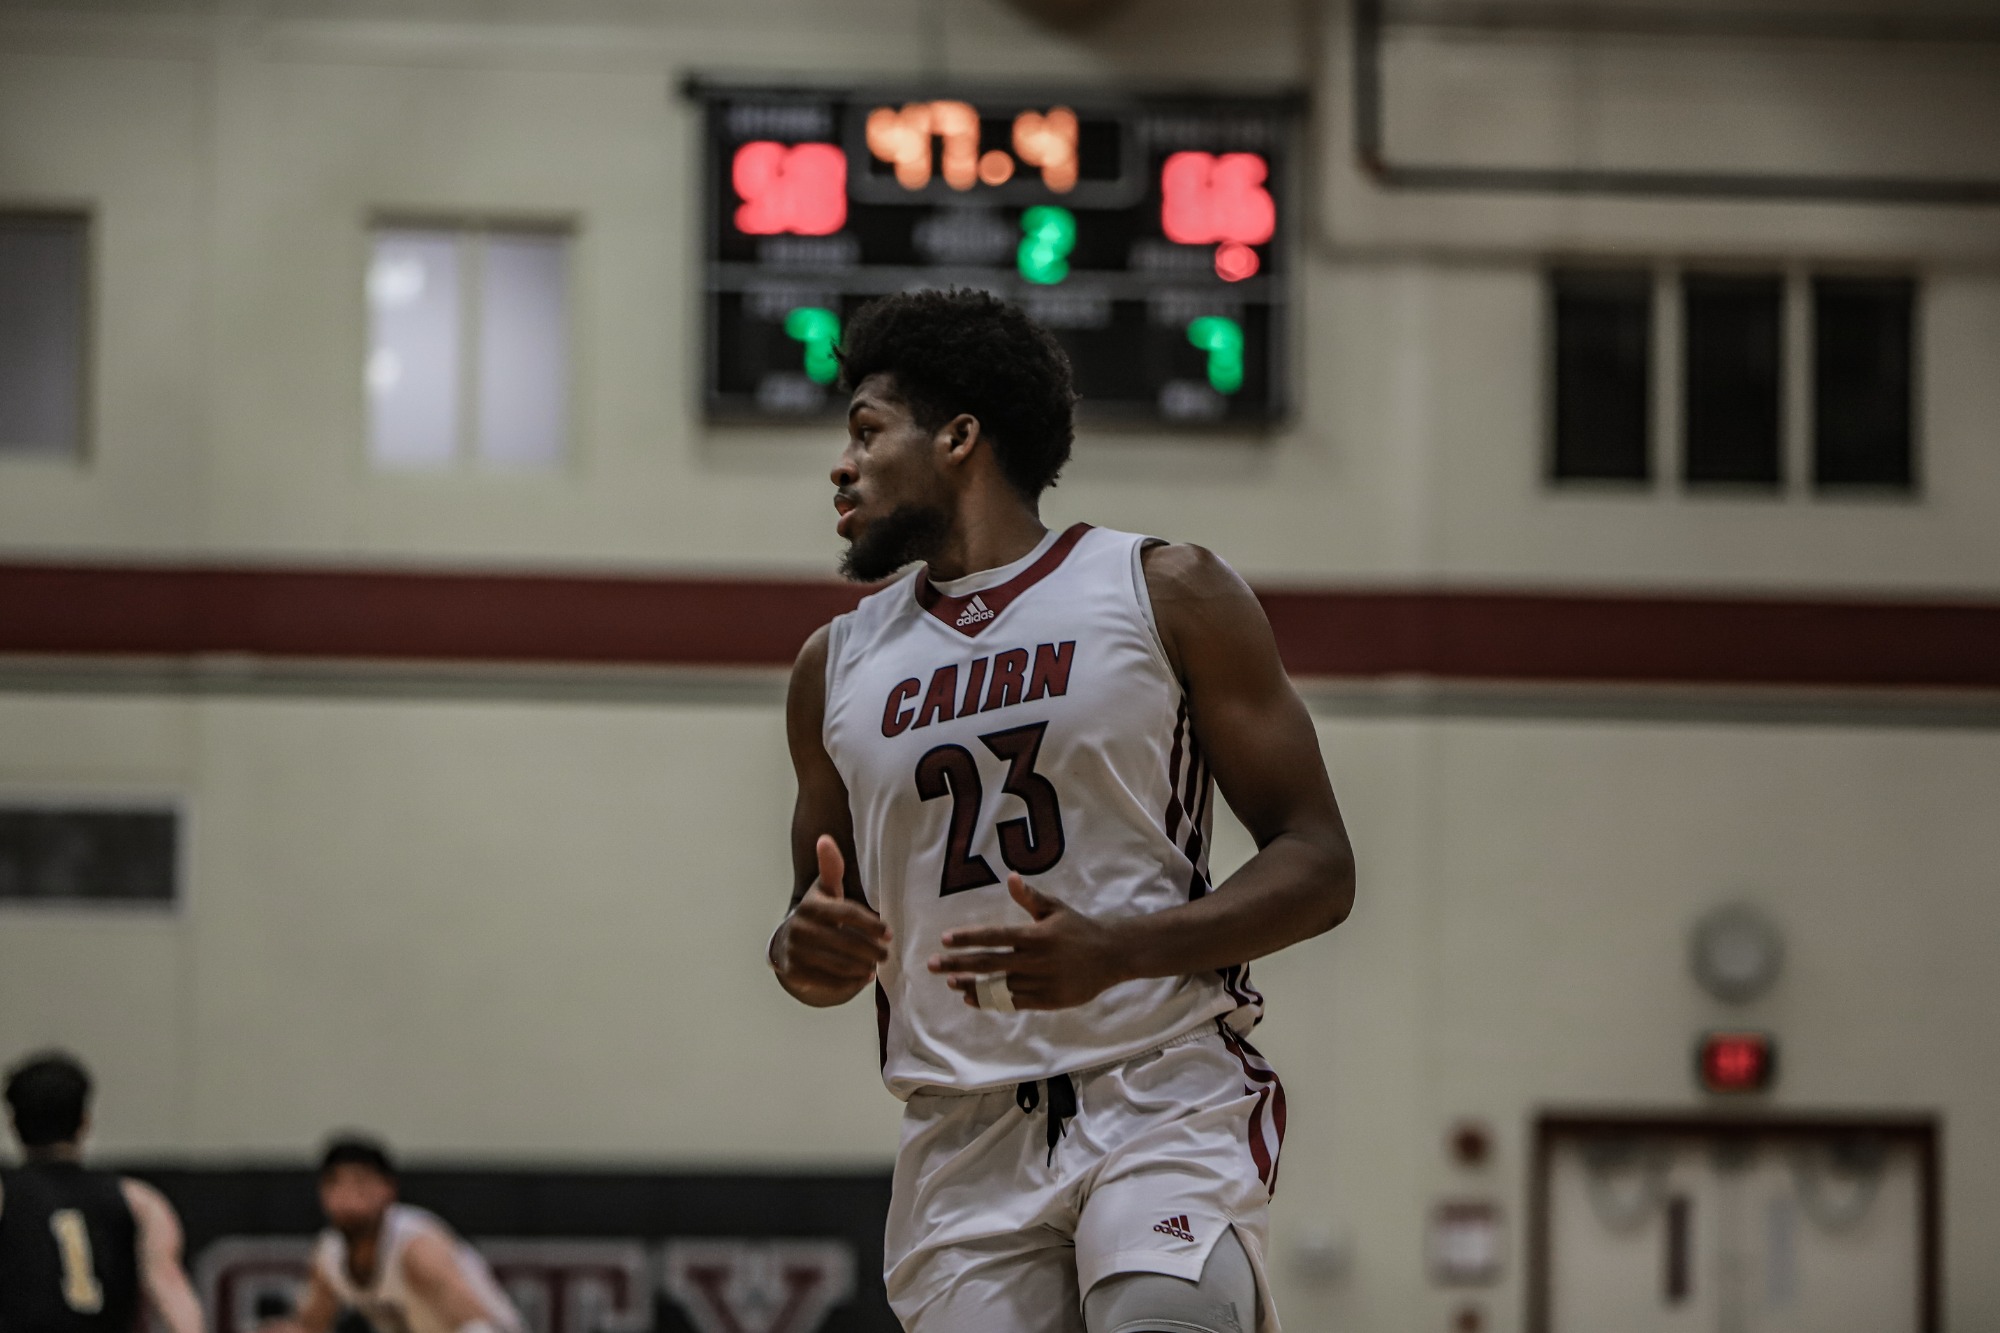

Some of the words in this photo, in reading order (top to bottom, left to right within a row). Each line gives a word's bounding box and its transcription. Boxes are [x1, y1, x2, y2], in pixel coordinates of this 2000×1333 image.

[956, 609, 995, 627] adidas
[881, 640, 1076, 738] CAIRN
[914, 720, 1066, 898] 23
[50, 1208, 104, 1314] 1
[1153, 1223, 1194, 1242] adidas
